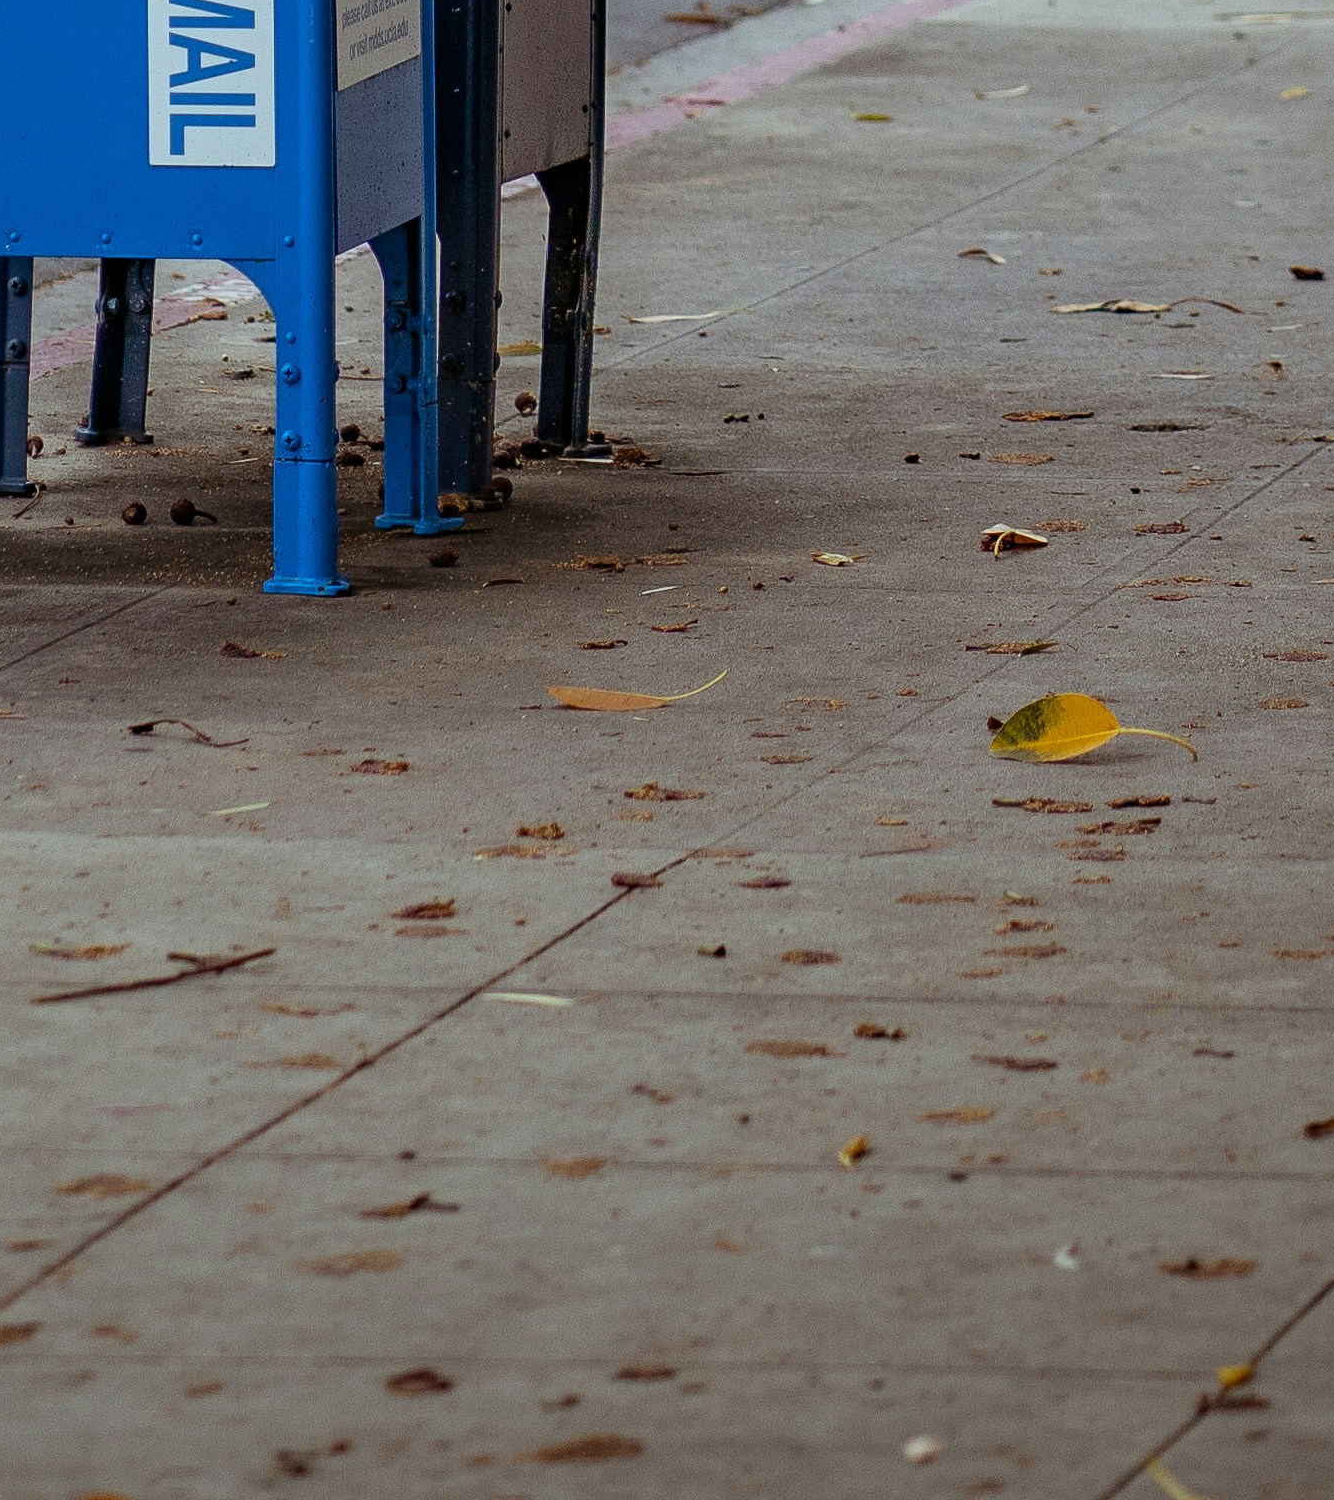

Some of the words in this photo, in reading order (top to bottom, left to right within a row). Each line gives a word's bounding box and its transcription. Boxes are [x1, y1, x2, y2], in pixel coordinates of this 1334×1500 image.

[342, 5, 360, 32] please
[349, 43, 356, 61] or
[357, 33, 368, 57] visit
